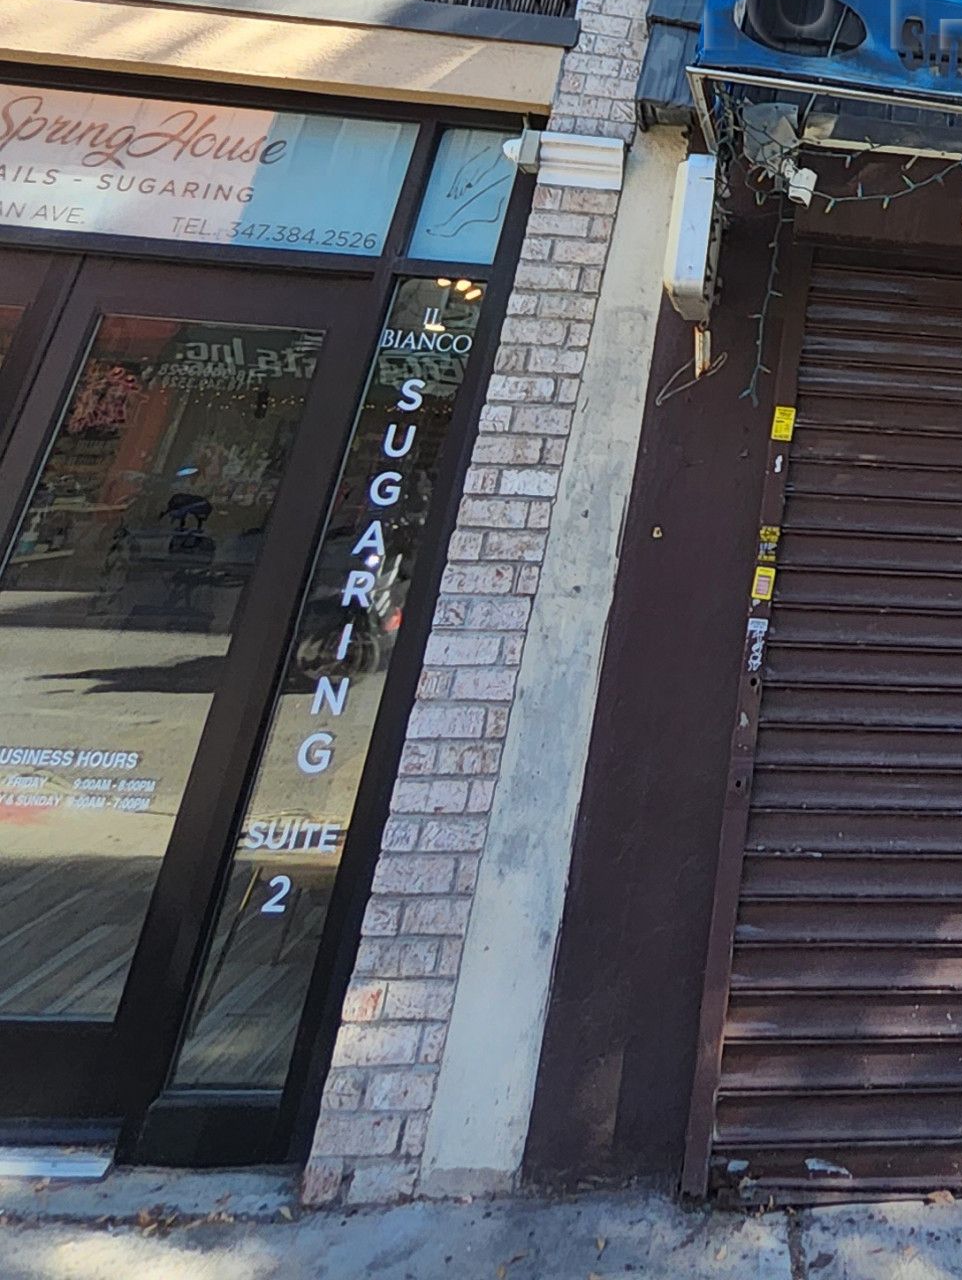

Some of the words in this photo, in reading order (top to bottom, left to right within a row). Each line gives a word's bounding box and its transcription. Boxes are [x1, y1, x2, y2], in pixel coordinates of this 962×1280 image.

[126, 110, 287, 165] House
[96, 174, 255, 203] SUGARING
[225, 221, 379, 250] 347.384.2526
[381, 329, 473, 354] BIANCO
[297, 377, 425, 774] SUGARING
[75, 750, 140, 770] HOURS
[244, 820, 342, 853] SUITE
[261, 874, 292, 913] 2
